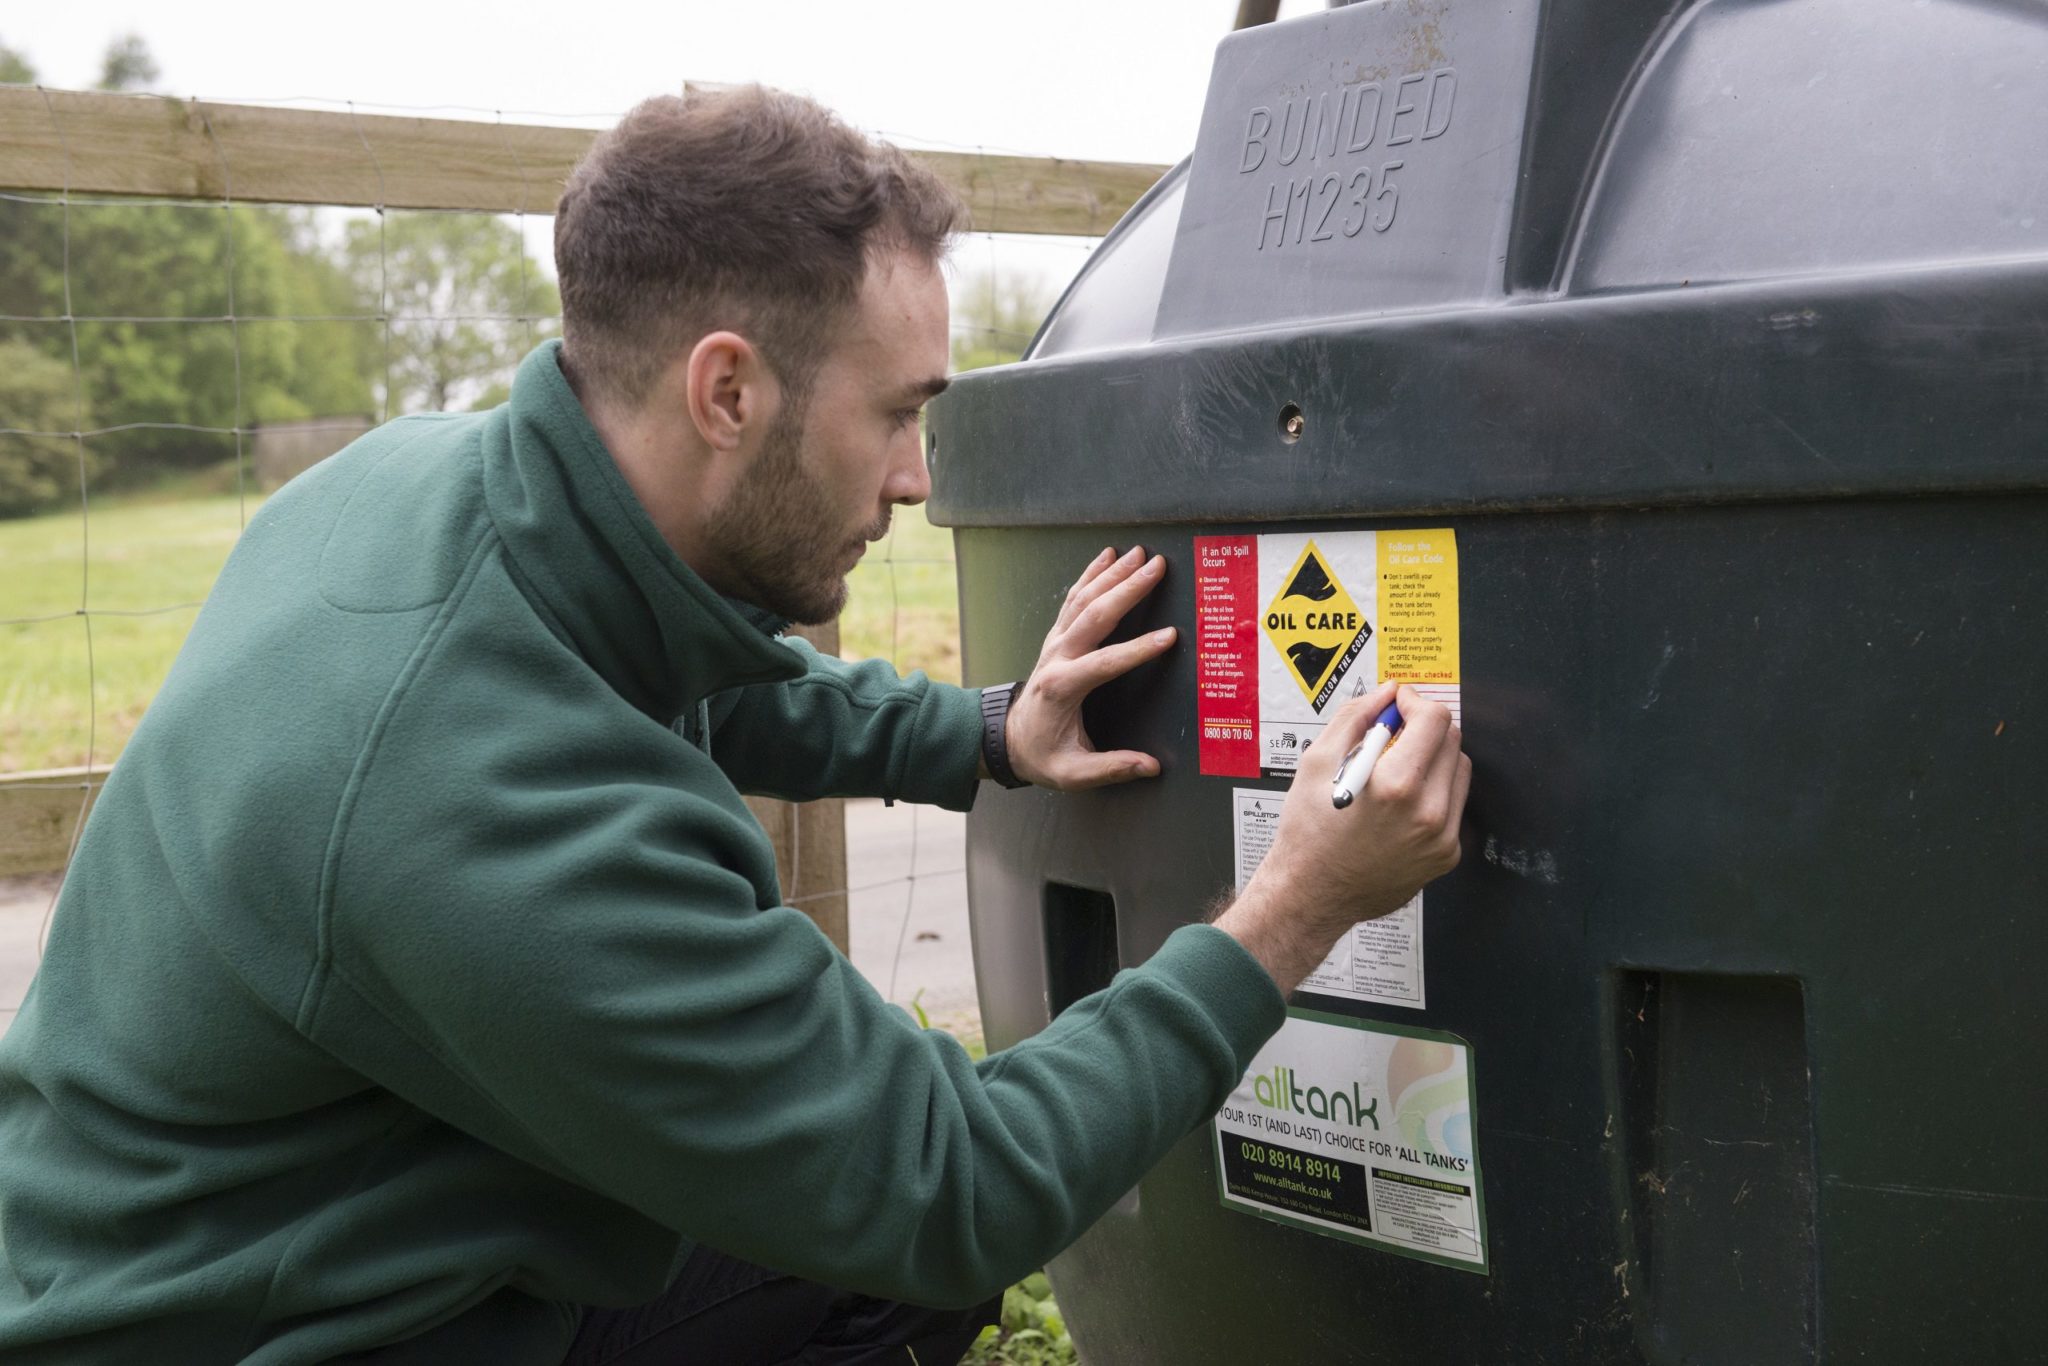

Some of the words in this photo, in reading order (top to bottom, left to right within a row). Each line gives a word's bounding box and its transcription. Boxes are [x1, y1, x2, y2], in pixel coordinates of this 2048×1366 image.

[1240, 67, 1457, 174] BUNDED
[1258, 160, 1404, 250] H1235
[1201, 546, 1208, 557] If
[1210, 548, 1219, 556] an
[1221, 546, 1232, 556] Oil
[1233, 545, 1249, 558] Spill
[1388, 543, 1414, 552] Follow
[1418, 541, 1431, 551] the
[1202, 558, 1226, 567] Occurs
[1388, 554, 1400, 564] Oil
[1402, 555, 1420, 565] Care
[1423, 553, 1445, 564] Code
[1389, 610, 1410, 618] receiving
[1267, 612, 1297, 631] OIL
[1305, 612, 1357, 631] CARE
[1412, 654, 1437, 662] Registered
[1315, 675, 1338, 709] FOLLOW
[1338, 655, 1352, 674] THE
[1351, 626, 1369, 654] CODE
[1384, 670, 1408, 679] System
[1424, 671, 1453, 679] checked
[1204, 727, 1221, 739] 0800
[1221, 728, 1231, 740] 80
[1232, 728, 1241, 740] 70
[1243, 728, 1253, 741] 60
[1269, 739, 1292, 749] SEPA
[1254, 1065, 1380, 1131] alltank
[1218, 1105, 1245, 1126] YOUR
[1247, 1113, 1263, 1129] 1ST
[1265, 1117, 1292, 1136] (AND
[1294, 1123, 1322, 1145] LAST)
[1325, 1131, 1366, 1152] CHOICE
[1369, 1141, 1393, 1159] FOR
[1241, 1142, 1265, 1164] 020
[1268, 1149, 1302, 1173] 8914
[1306, 1158, 1342, 1183] 8914
[1253, 1172, 1333, 1200] www.alltank.co.uk
[1433, 1181, 1465, 1194] INFORMATION
